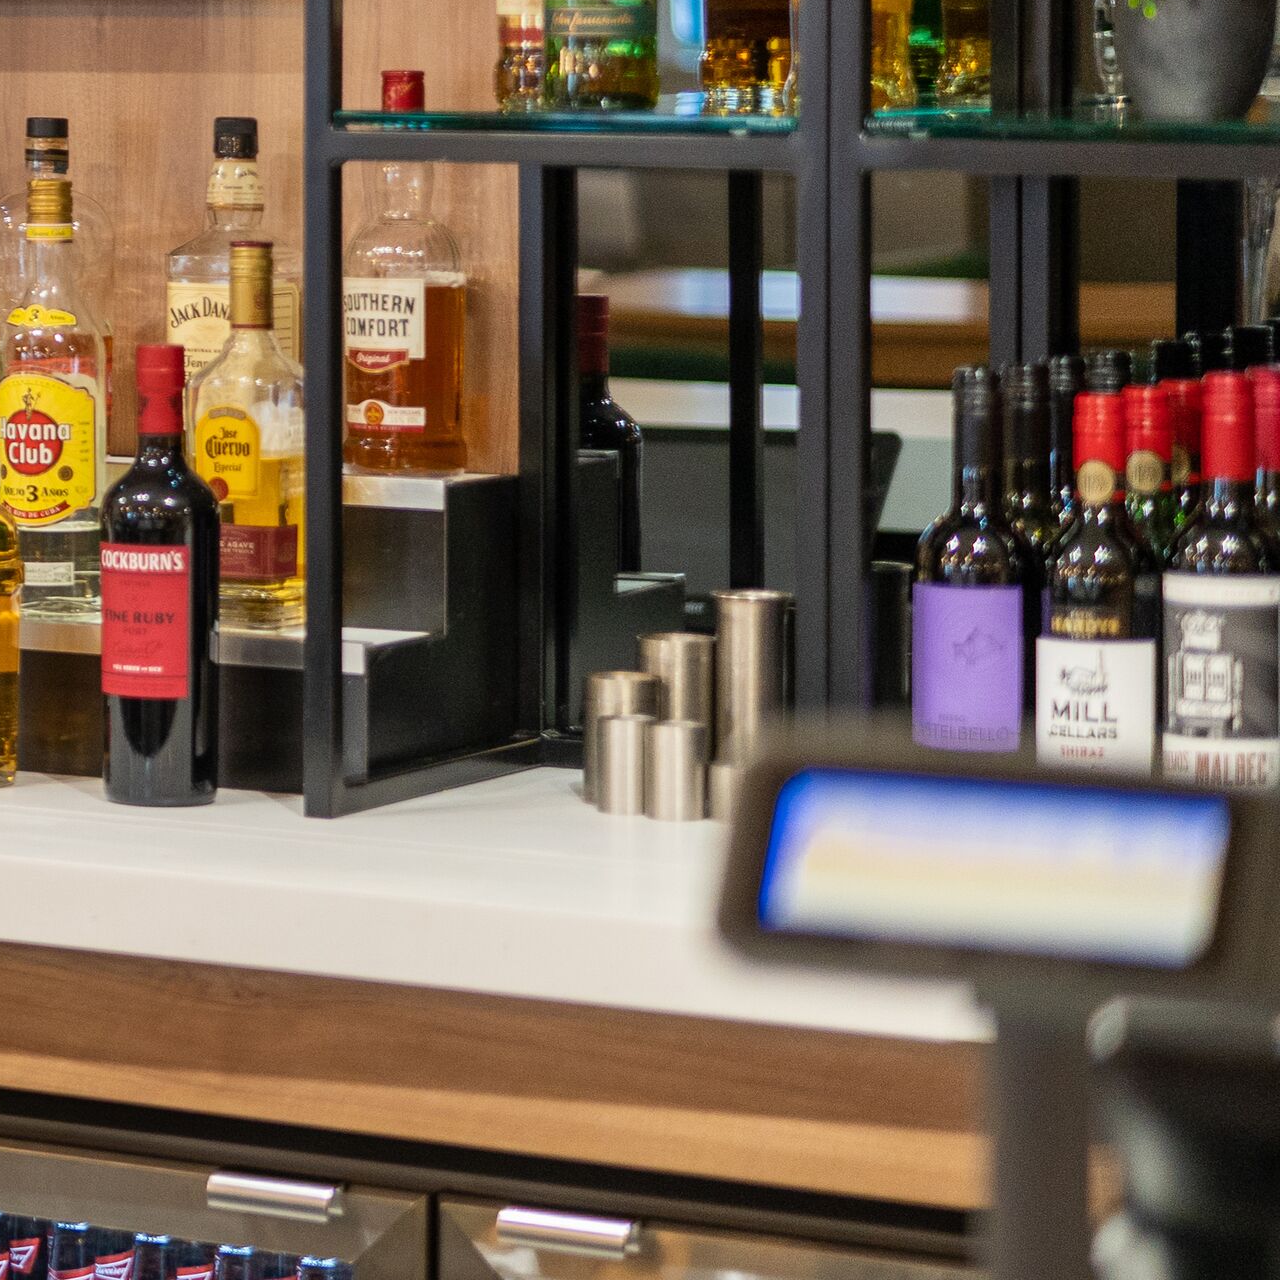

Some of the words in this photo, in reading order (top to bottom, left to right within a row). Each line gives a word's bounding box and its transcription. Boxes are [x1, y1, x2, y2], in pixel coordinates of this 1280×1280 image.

[343, 292, 416, 314] SOUTHERN
[170, 301, 200, 328] JACK
[346, 318, 409, 337] COMFORT
[356, 351, 391, 366] Original
[0, 416, 71, 440] Havana
[8, 442, 53, 465] Club
[205, 434, 251, 460] Cuervo
[26, 485, 38, 502] 3
[40, 506, 60, 517] CUBA
[101, 548, 184, 571] COCKBURN'S
[133, 611, 175, 624] RUBY
[1051, 699, 1118, 723] MILL
[1049, 726, 1118, 740] CELLARS
[1196, 751, 1268, 786] MALBEC
